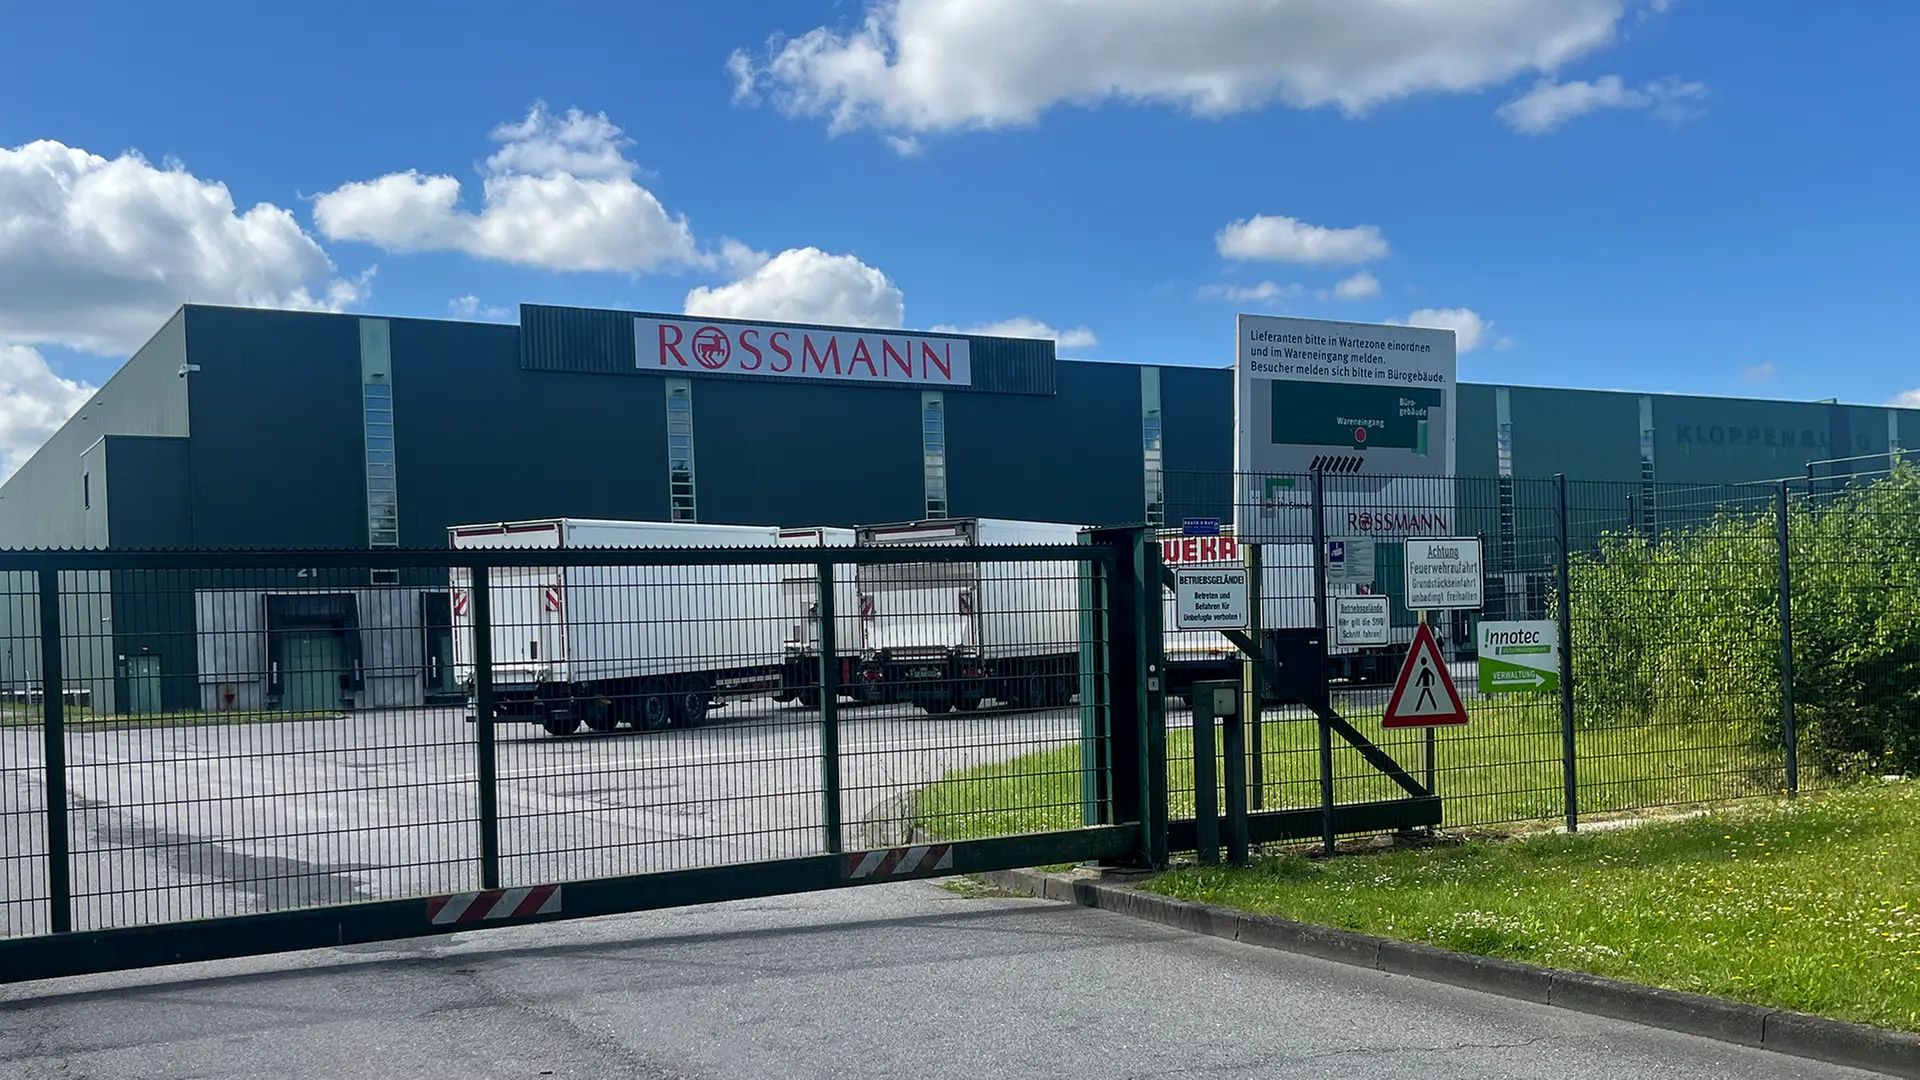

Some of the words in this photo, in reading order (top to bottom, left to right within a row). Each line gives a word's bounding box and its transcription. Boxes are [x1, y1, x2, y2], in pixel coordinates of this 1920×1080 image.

[1250, 330, 1302, 344] Lieferanten
[1305, 333, 1327, 345] bitte
[1328, 334, 1337, 346] in
[1338, 336, 1386, 350] Wartezone
[1387, 340, 1431, 353] einordnen
[658, 323, 952, 381] ROSSMANN
[1250, 346, 1269, 357] und
[1270, 346, 1282, 358] im
[1284, 348, 1349, 364] Wareneingang
[1350, 353, 1386, 364] melden.
[1250, 360, 1295, 373] Besucher
[1296, 364, 1329, 376] melden
[1331, 365, 1350, 377] sich
[1352, 367, 1373, 378] bitte
[1374, 368, 1386, 379] im
[1387, 369, 1447, 384] Bürogebäude.
[1399, 407, 1428, 417] gebäude
[1336, 416, 1385, 428] Wareneingang
[1347, 512, 1448, 531] ROSSMANN
[1427, 545, 1459, 560] Achtung
[1410, 561, 1478, 574] Feuerwehrzufahrt
[1179, 574, 1245, 585] BETRIEBSGELÄNDE!
[1411, 577, 1477, 589] Grundstückseinfahrt
[1194, 592, 1219, 600] Betreten
[1219, 592, 1231, 600] und
[1411, 592, 1444, 604] unbedingt
[1446, 590, 1478, 601] freihalten
[1195, 602, 1221, 611] Befahren
[1221, 602, 1231, 611] für
[1183, 613, 1213, 622] Unbefugte
[1213, 613, 1236, 621] verboten
[1492, 670, 1536, 680] VERWALTUNG
